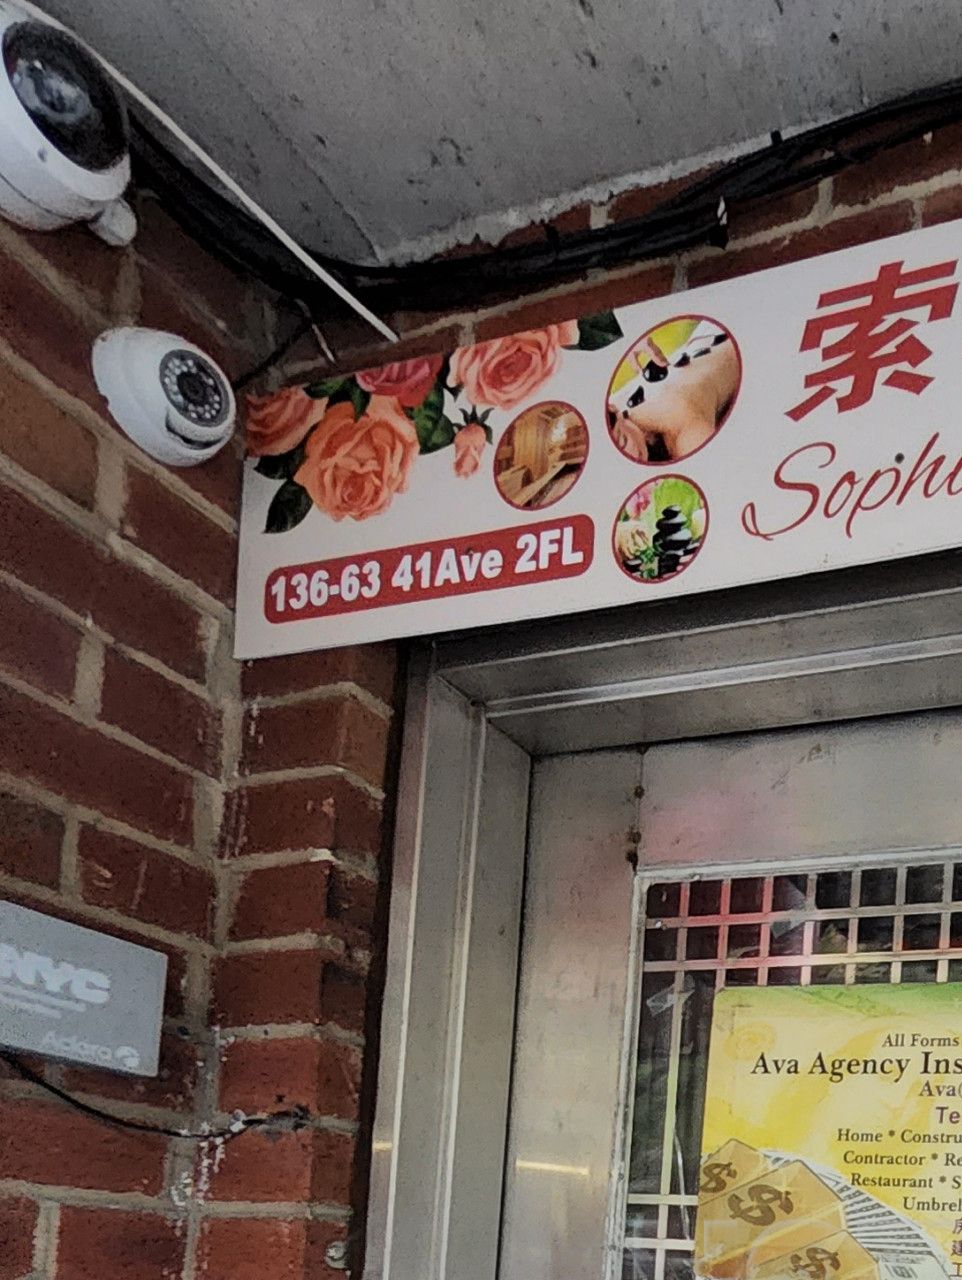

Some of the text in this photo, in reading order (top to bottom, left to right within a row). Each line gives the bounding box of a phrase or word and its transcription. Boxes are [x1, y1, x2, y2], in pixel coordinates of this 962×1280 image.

[271, 527, 584, 612] 136-63 41Ave 2FL
[882, 1033, 905, 1048] All
[910, 1033, 960, 1048] Forms
[750, 1052, 800, 1075] Ava
[808, 1051, 911, 1083] Agency
[837, 1128, 883, 1143] Home
[843, 1150, 926, 1166] Contractor
[850, 1172, 934, 1189] Restaurant
